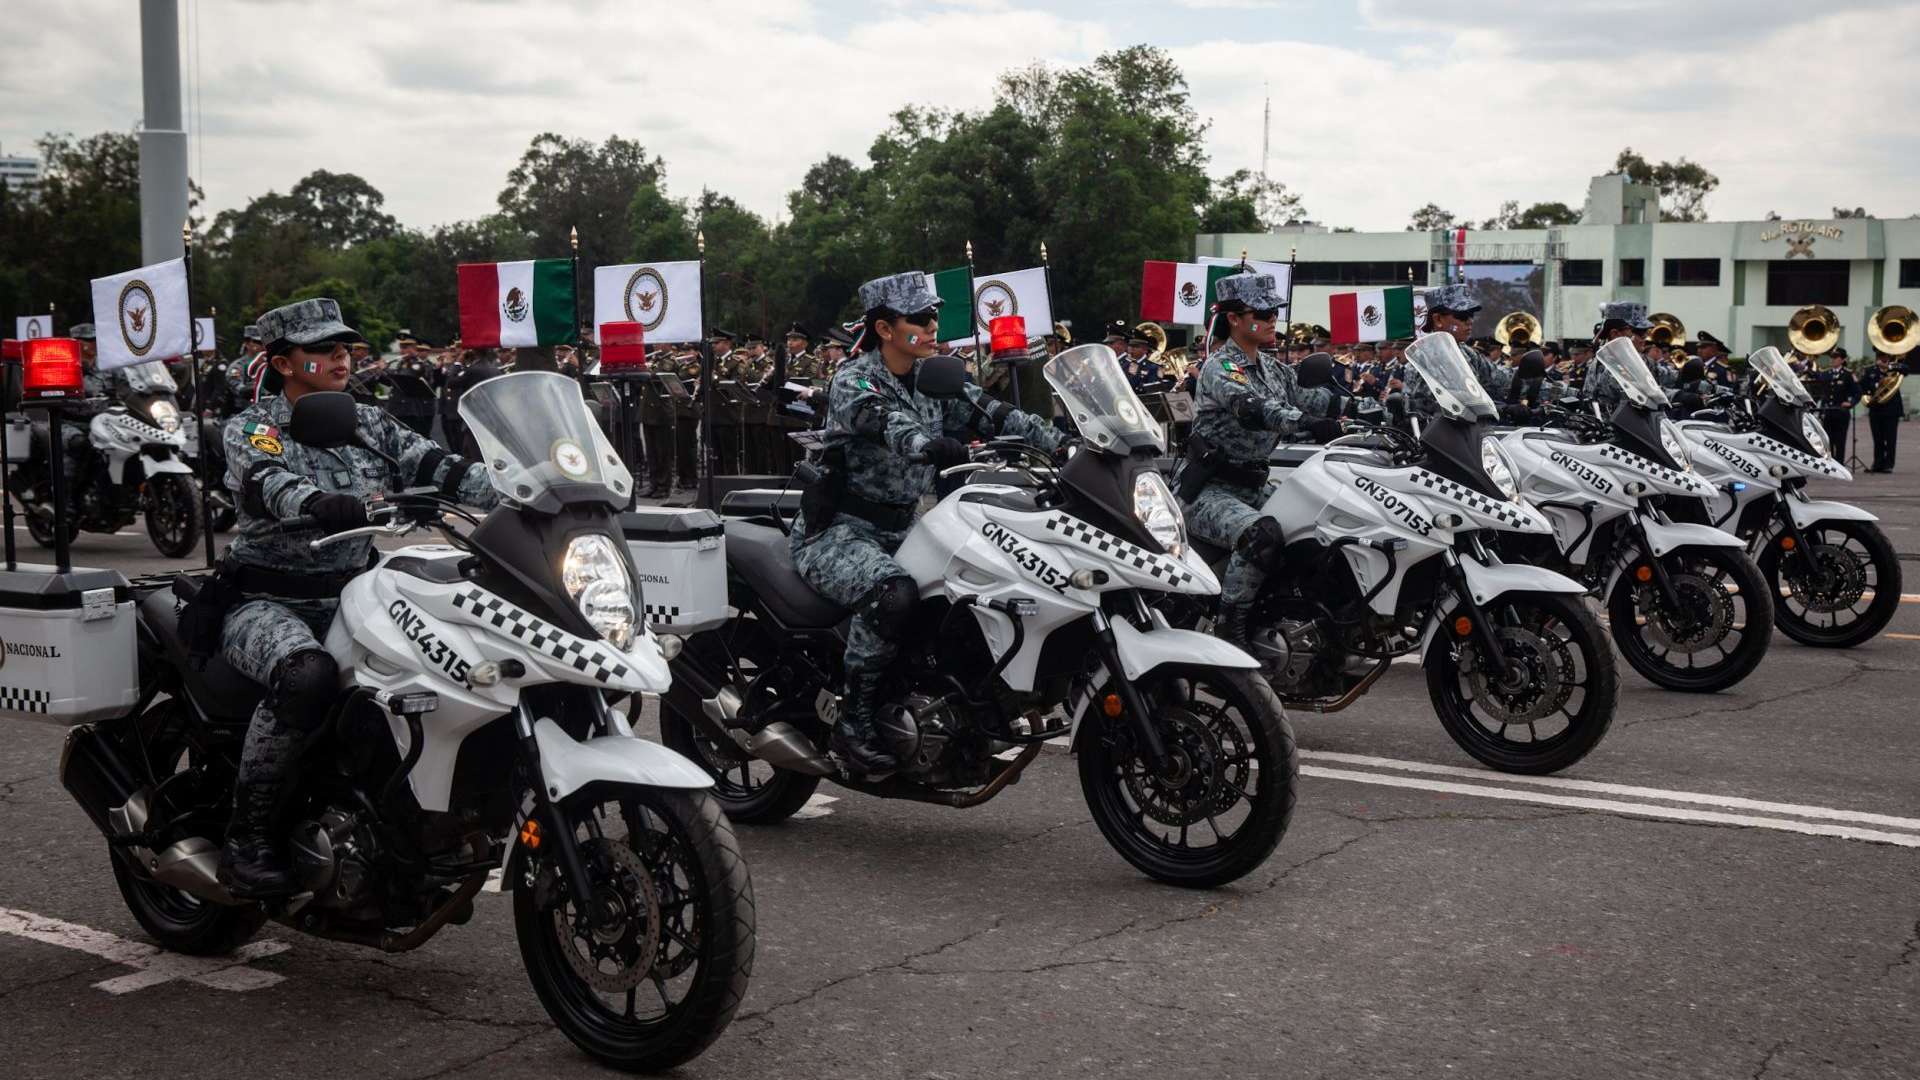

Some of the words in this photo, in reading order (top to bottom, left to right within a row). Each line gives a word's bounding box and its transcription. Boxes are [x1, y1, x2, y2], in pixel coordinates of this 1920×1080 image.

[1550, 451, 1613, 494] GN313151
[1704, 439, 1762, 478] GN332153
[1355, 476, 1433, 536] GN307153
[982, 521, 1070, 594] GN343152
[5, 642, 61, 658] NACIONAL
[388, 599, 473, 692] GN34315
